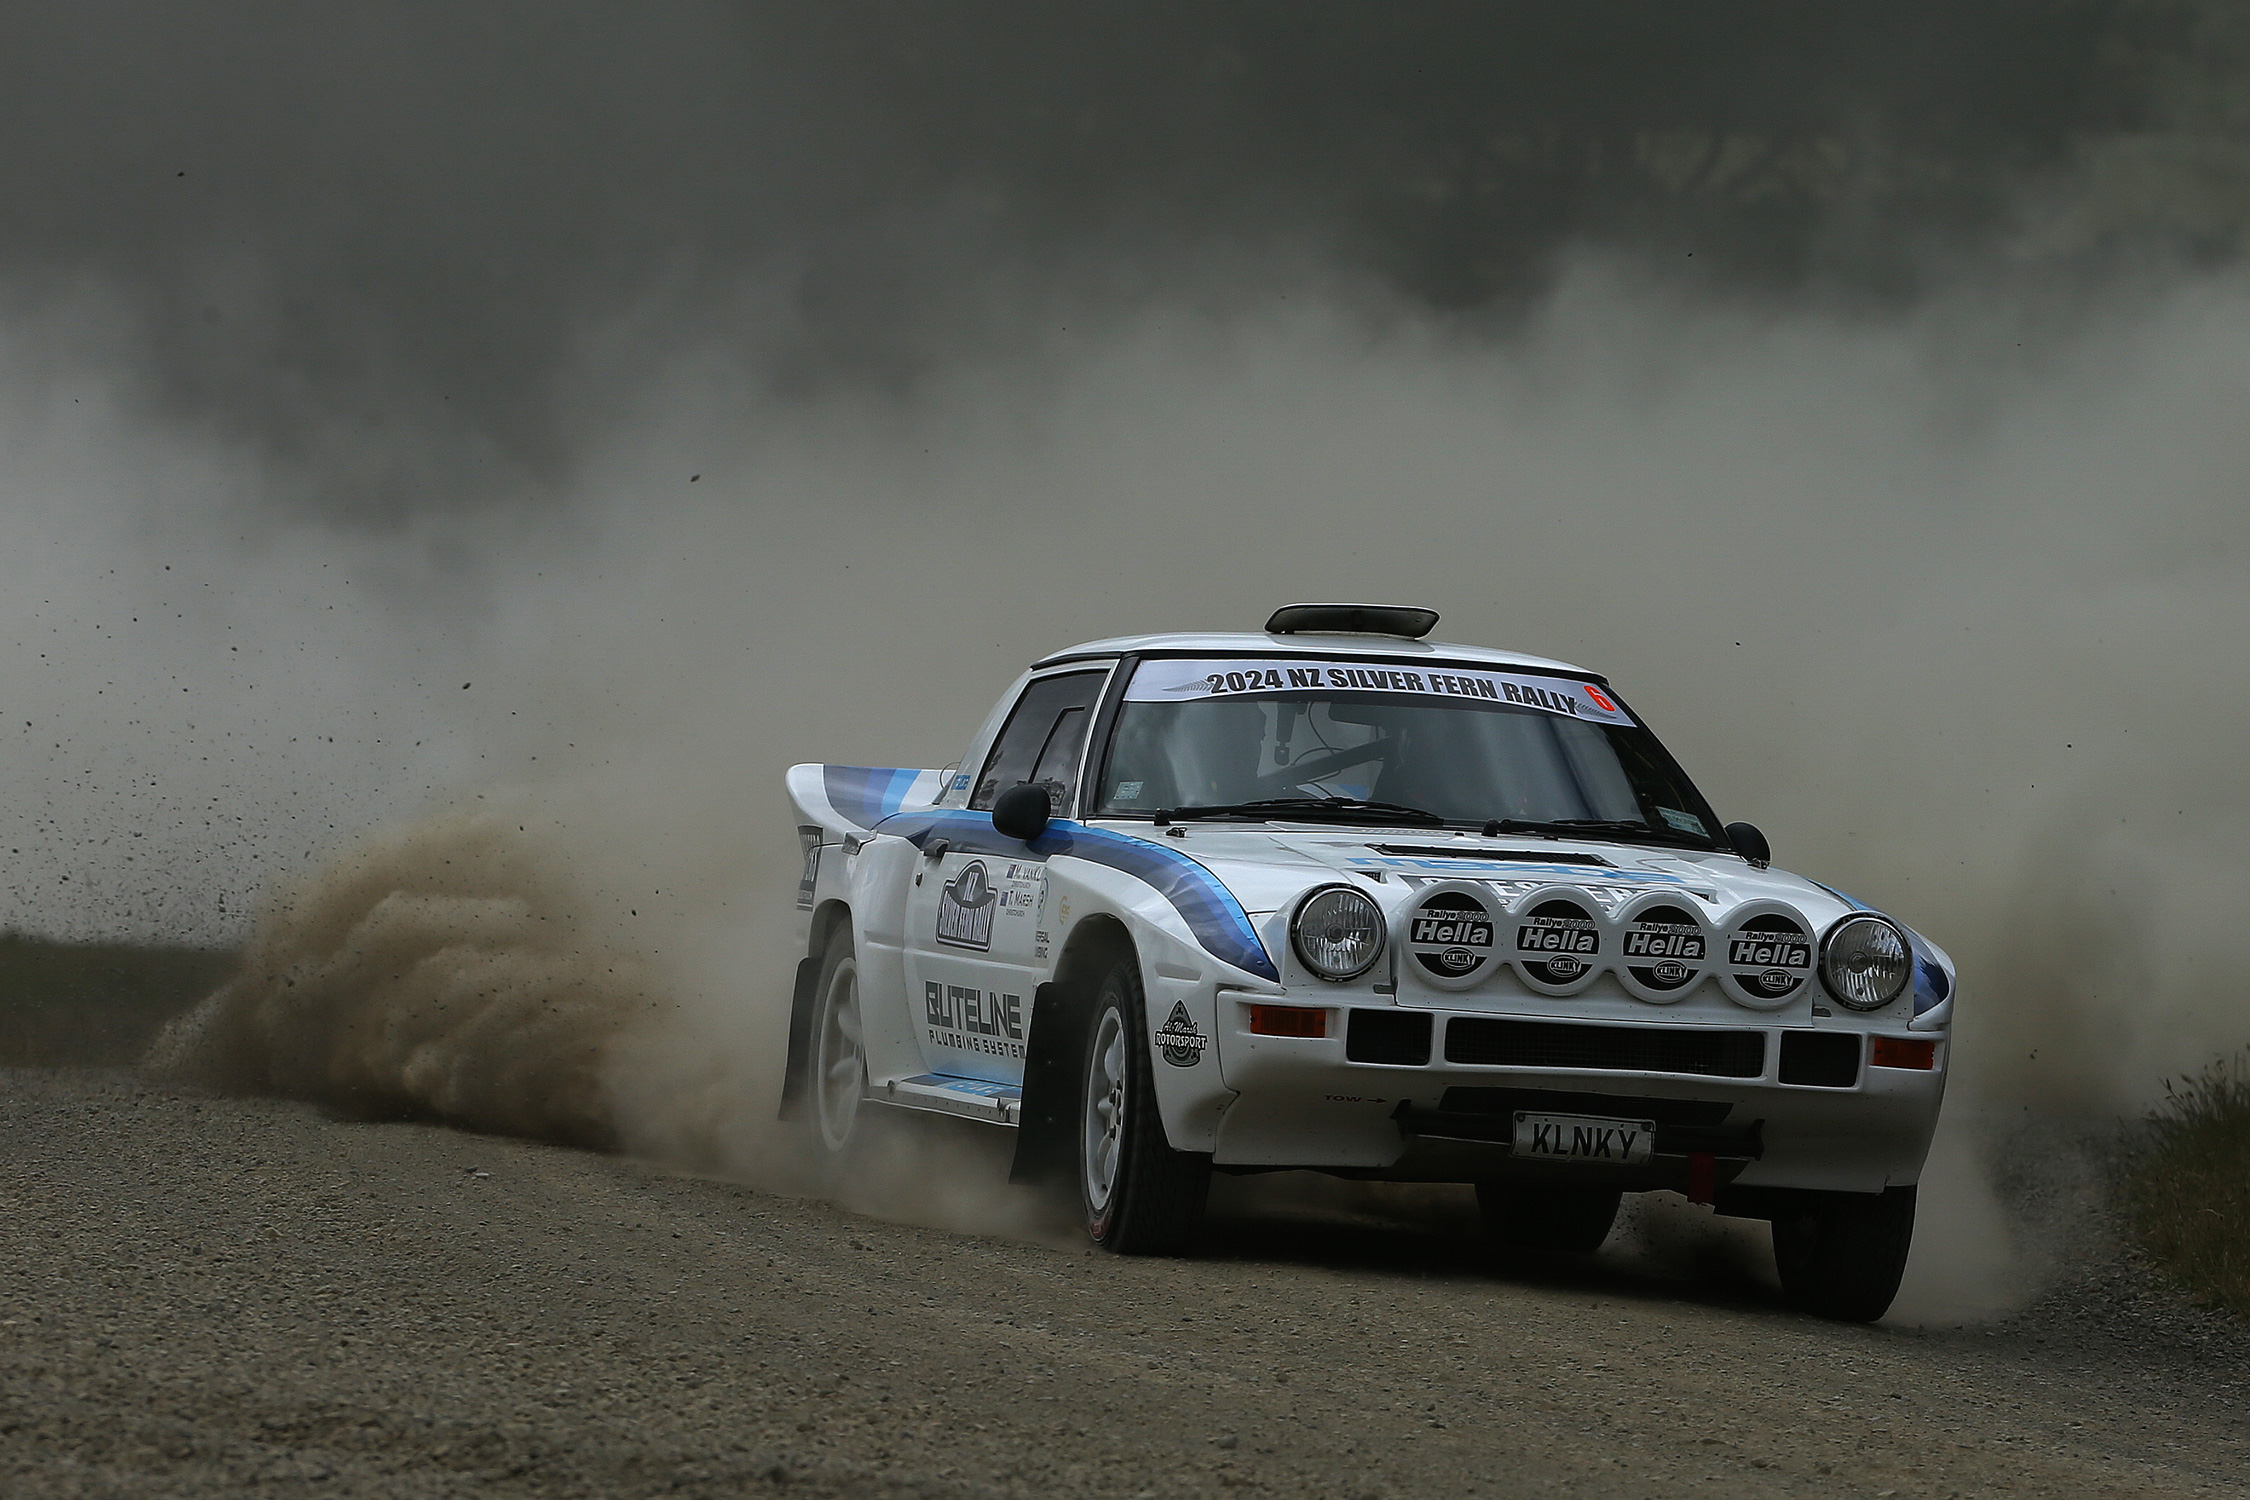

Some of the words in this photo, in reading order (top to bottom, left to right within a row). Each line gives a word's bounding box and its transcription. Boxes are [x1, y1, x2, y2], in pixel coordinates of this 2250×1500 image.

[1207, 668, 1284, 694] 2024
[1287, 668, 1325, 688] NZ
[1327, 668, 1426, 692] SILVER
[1427, 673, 1499, 699] FERN
[1501, 681, 1578, 716] RALLY
[1584, 685, 1616, 712] 6
[1415, 920, 1488, 944] Hella
[1522, 928, 1595, 951] Hella
[1628, 933, 1700, 957] Hella
[1734, 942, 1807, 965] Hella
[1444, 953, 1475, 966] KLINKY
[1550, 960, 1582, 973] KLINKY
[1657, 966, 1688, 978] KLINKY
[1762, 974, 1794, 987] KLINKY
[925, 980, 1023, 1040] BUTELINE
[928, 1029, 981, 1053] PLUMBING
[1156, 1033, 1207, 1049] ROTORSPORT
[1324, 1094, 1362, 1103] TOW
[1530, 1123, 1638, 1160] KLNKY
